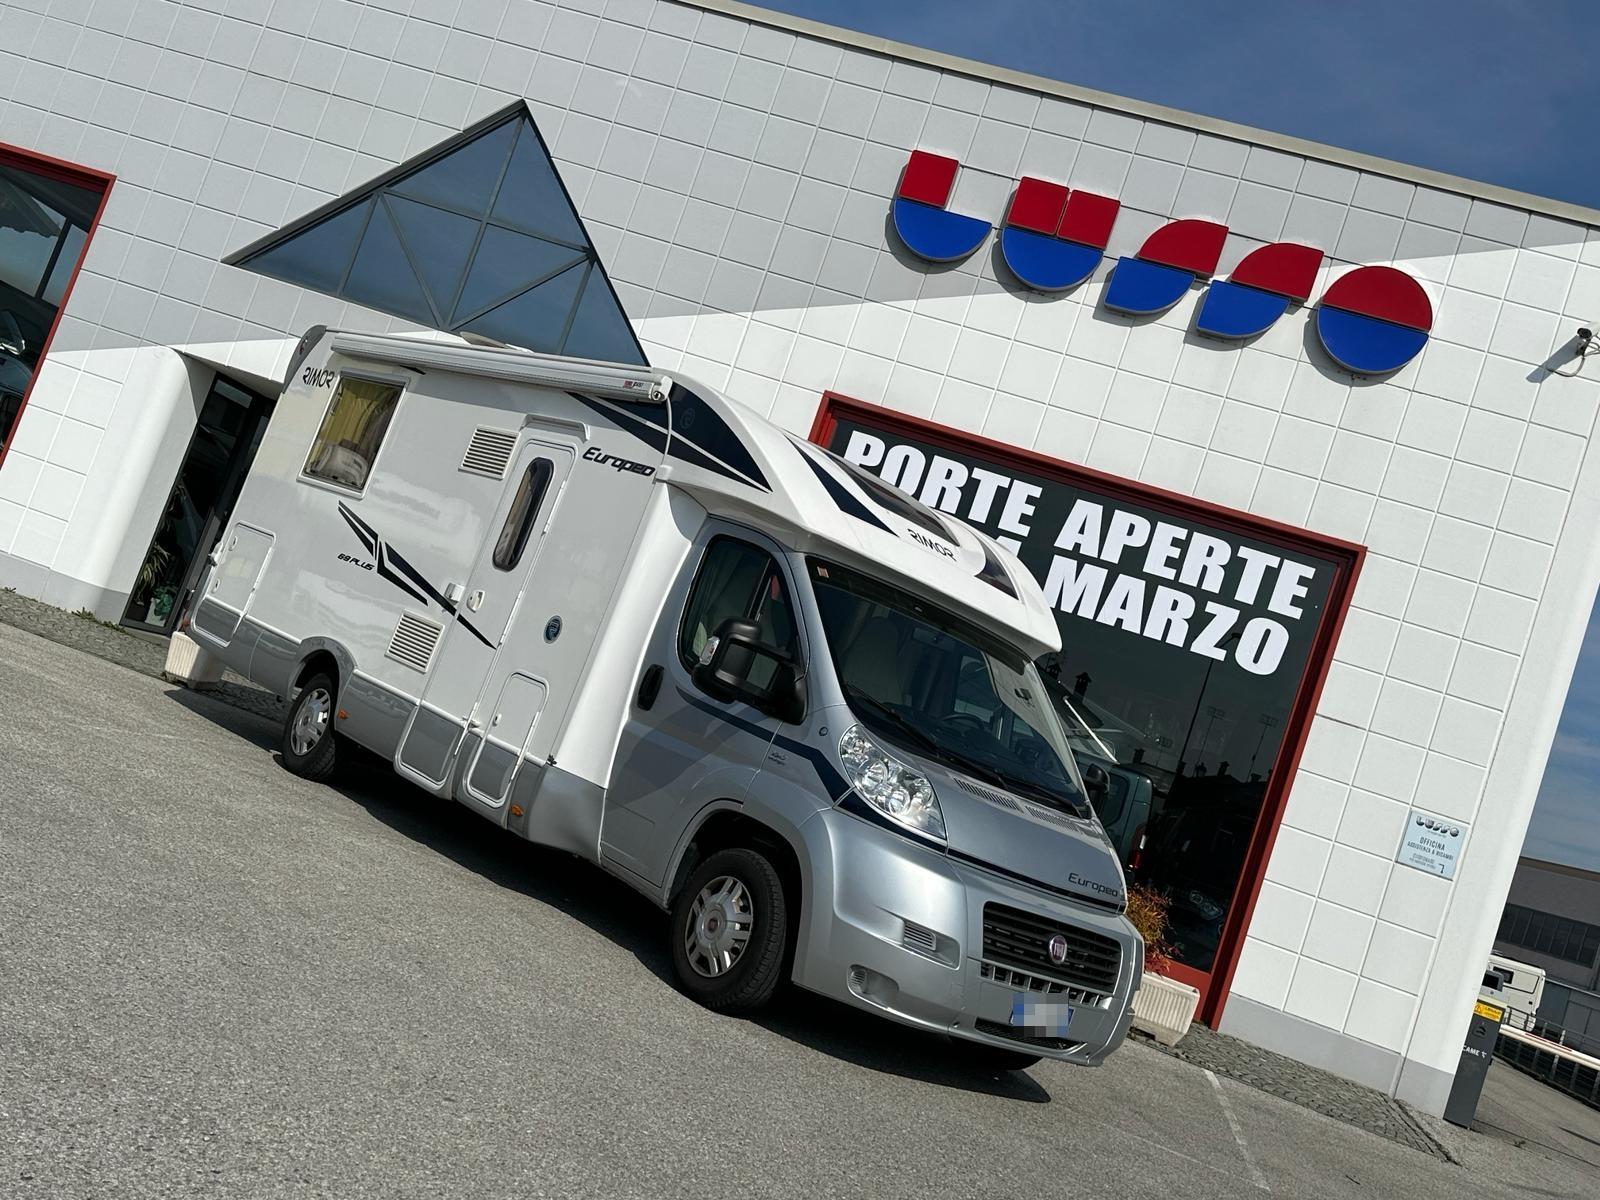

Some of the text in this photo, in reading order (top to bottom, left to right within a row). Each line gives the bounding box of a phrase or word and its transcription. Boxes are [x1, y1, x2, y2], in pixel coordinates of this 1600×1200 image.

[303, 367, 335, 389] RIMOR
[582, 446, 656, 477] Europeo
[843, 430, 1316, 620] PORTE APERTE
[907, 528, 957, 561] RIMOR
[337, 553, 375, 571] 69 PLUS
[1044, 554, 1290, 676] MARZO
[1420, 837, 1445, 851] OFFICINA
[1068, 872, 1118, 897] Europeo
